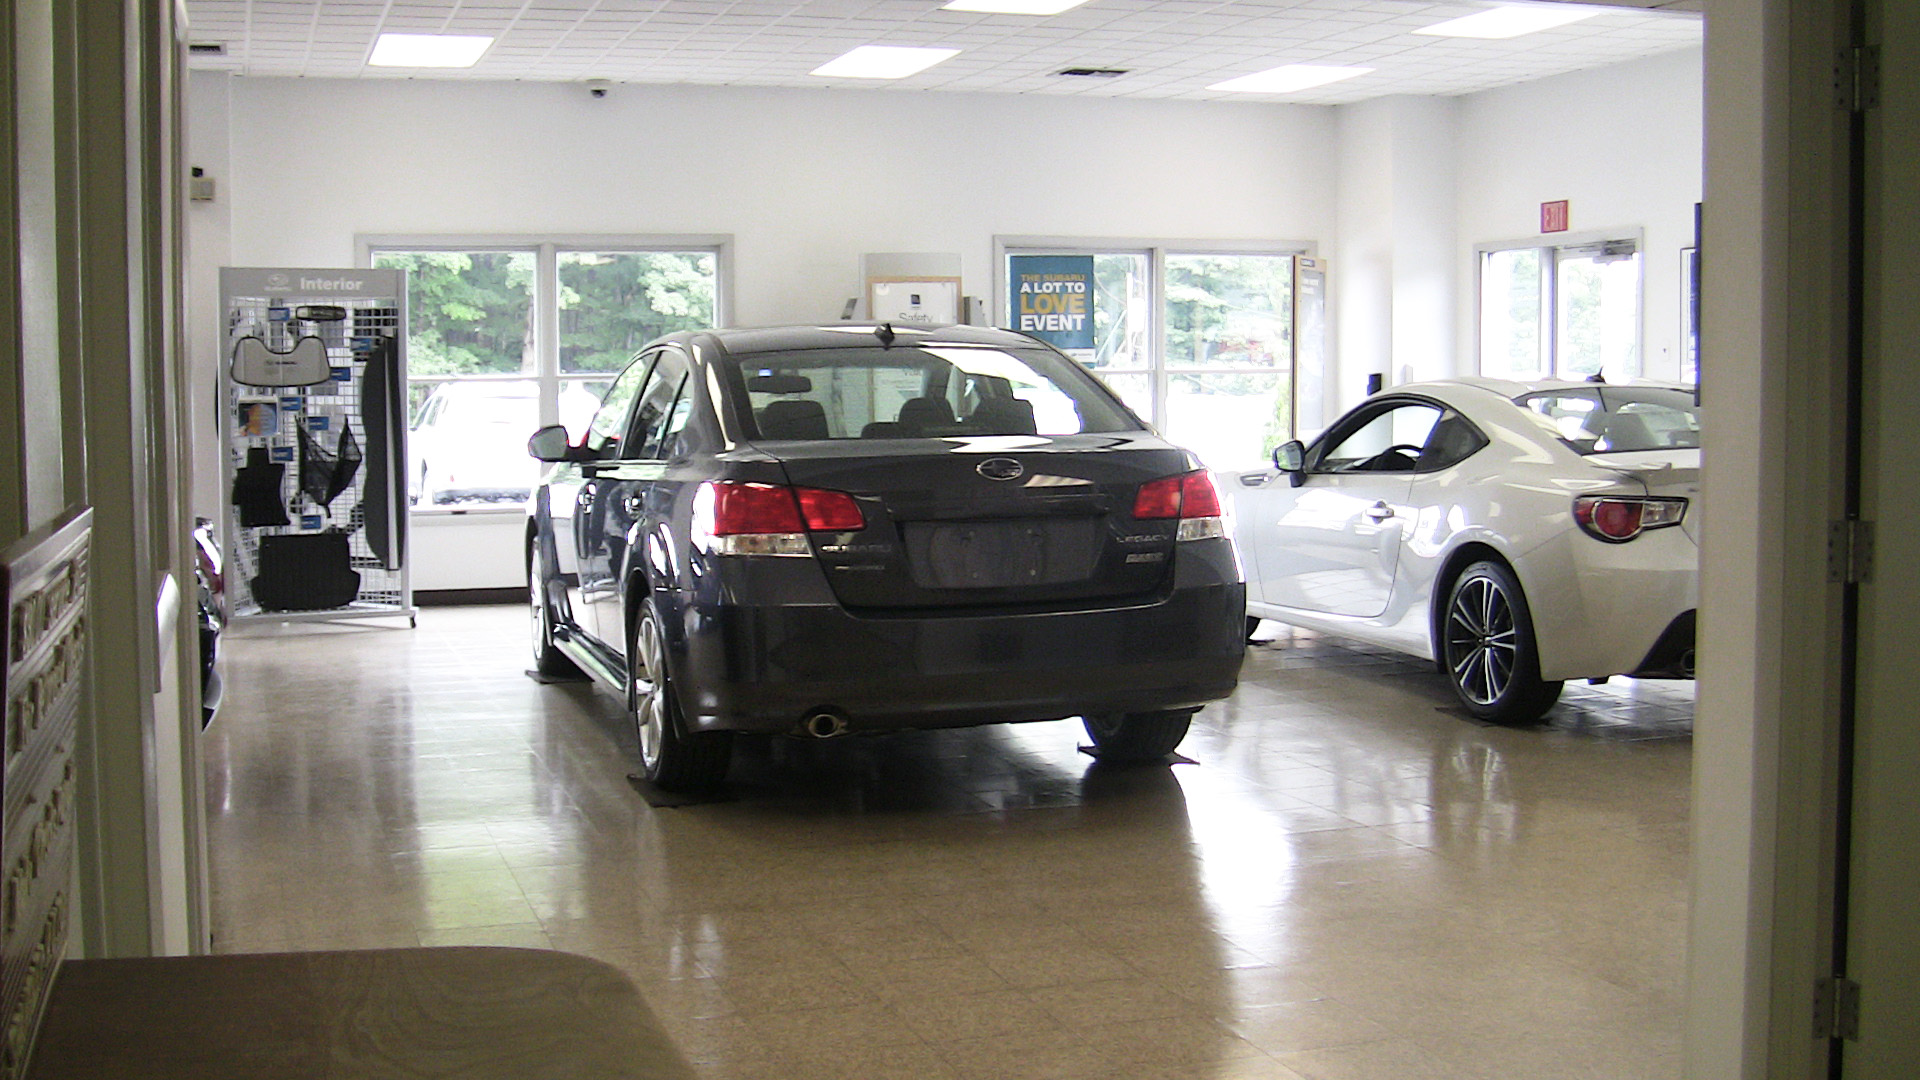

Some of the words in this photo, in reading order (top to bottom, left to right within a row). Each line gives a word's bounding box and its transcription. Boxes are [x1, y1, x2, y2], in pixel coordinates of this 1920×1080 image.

[300, 277, 362, 290] Interior
[1020, 282, 1032, 293] A
[1033, 282, 1063, 293] LOT
[1064, 282, 1086, 293] TO
[1020, 294, 1086, 314] LOVE
[899, 312, 933, 324] Safety
[1020, 314, 1086, 331] EVENT
